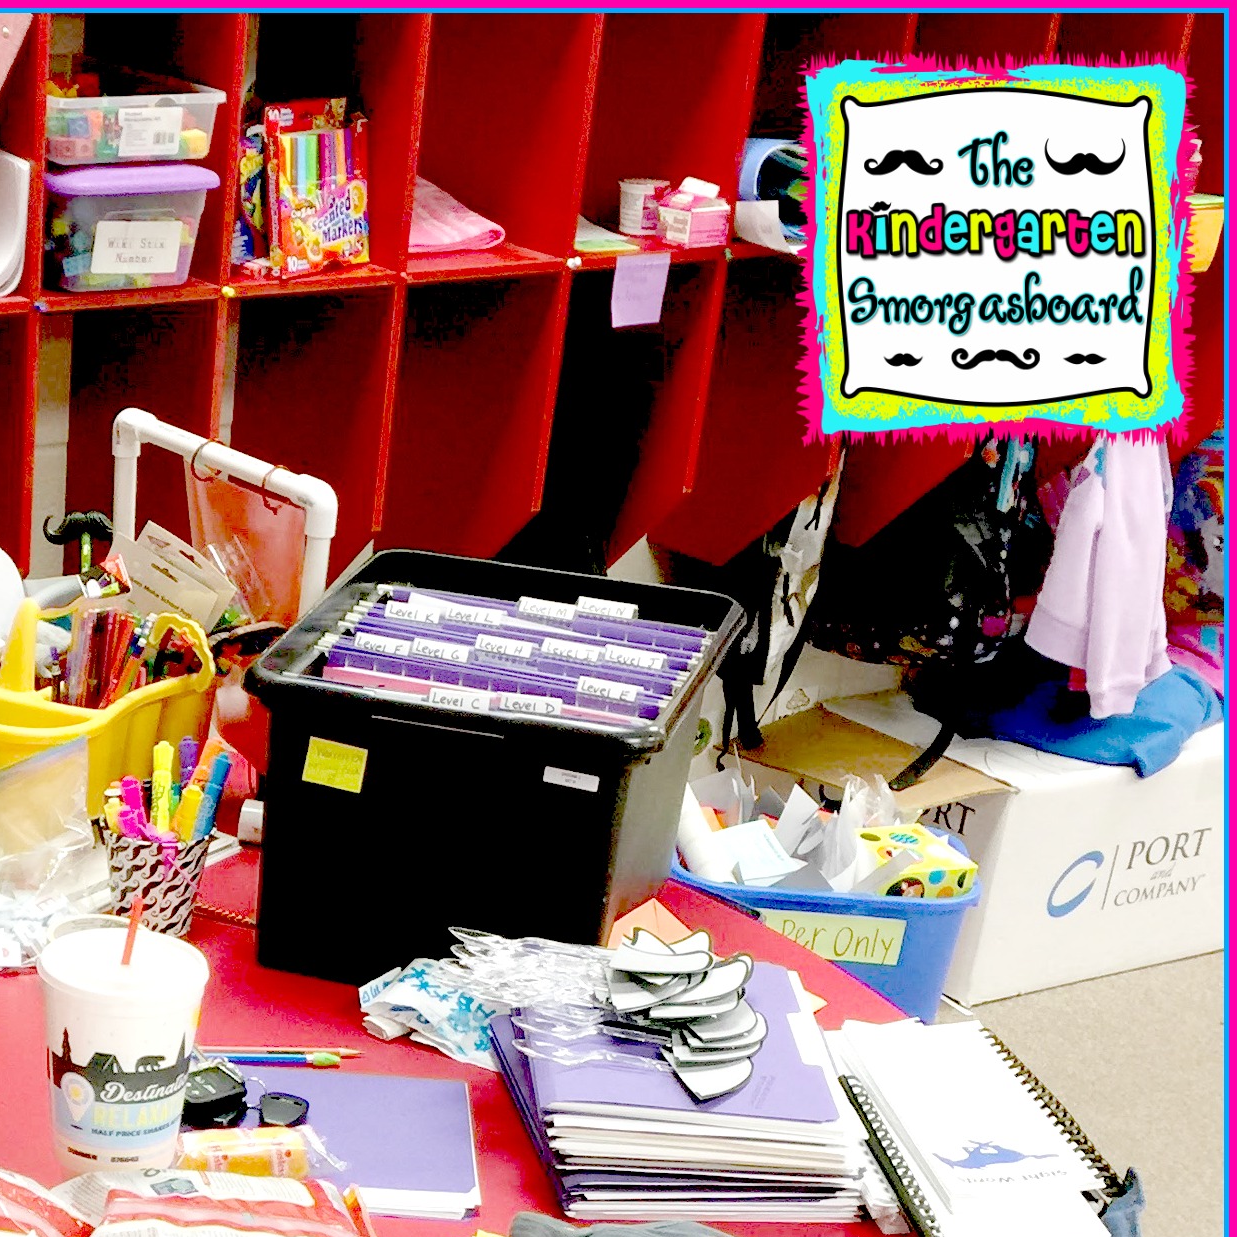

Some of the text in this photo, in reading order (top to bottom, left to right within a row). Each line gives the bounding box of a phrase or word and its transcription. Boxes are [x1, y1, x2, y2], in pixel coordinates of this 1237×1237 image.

[140, 237, 165, 249] Stix
[389, 604, 435, 623] Level K
[448, 608, 494, 623] Level L
[522, 602, 567, 617] Level M
[582, 601, 626, 616] Level N
[356, 634, 403, 654] Level F
[415, 641, 460, 659] Level G
[480, 638, 523, 655] Level H
[547, 642, 596, 662] Level I
[609, 652, 661, 668] Level J
[581, 680, 630, 700] Level E
[432, 694, 480, 709] Level C
[504, 698, 556, 714] Level D
[1126, 827, 1212, 870] PORT
[1149, 862, 1173, 881] and
[1113, 873, 1206, 908] COMPANY
[833, 926, 895, 965] Only
